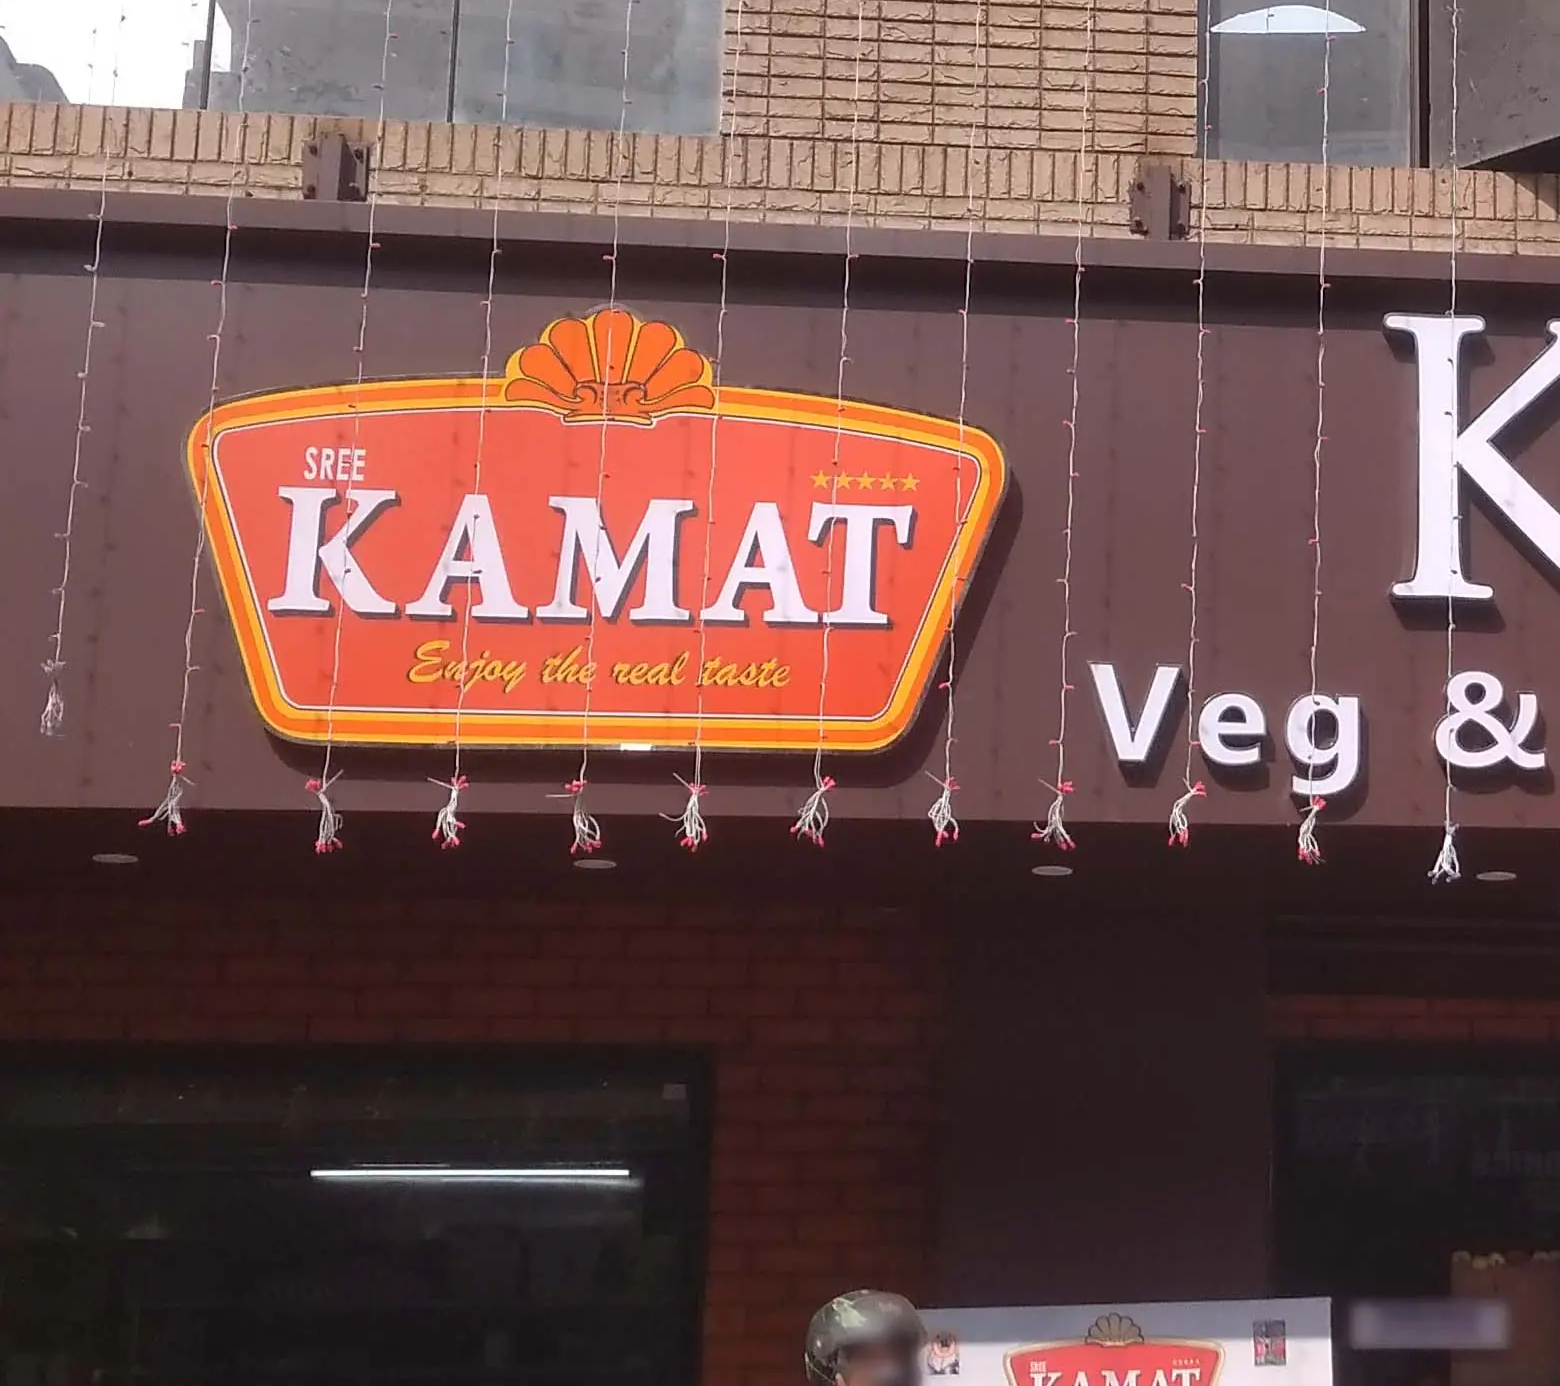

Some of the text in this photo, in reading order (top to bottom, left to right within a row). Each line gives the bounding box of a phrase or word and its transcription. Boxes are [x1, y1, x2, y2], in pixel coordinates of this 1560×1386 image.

[304, 447, 366, 481] SREE
[267, 486, 912, 624] KAMAT
[407, 641, 791, 693] Enjoy the real taste
[1088, 662, 1361, 796] Veg
[1435, 671, 1546, 770] &
